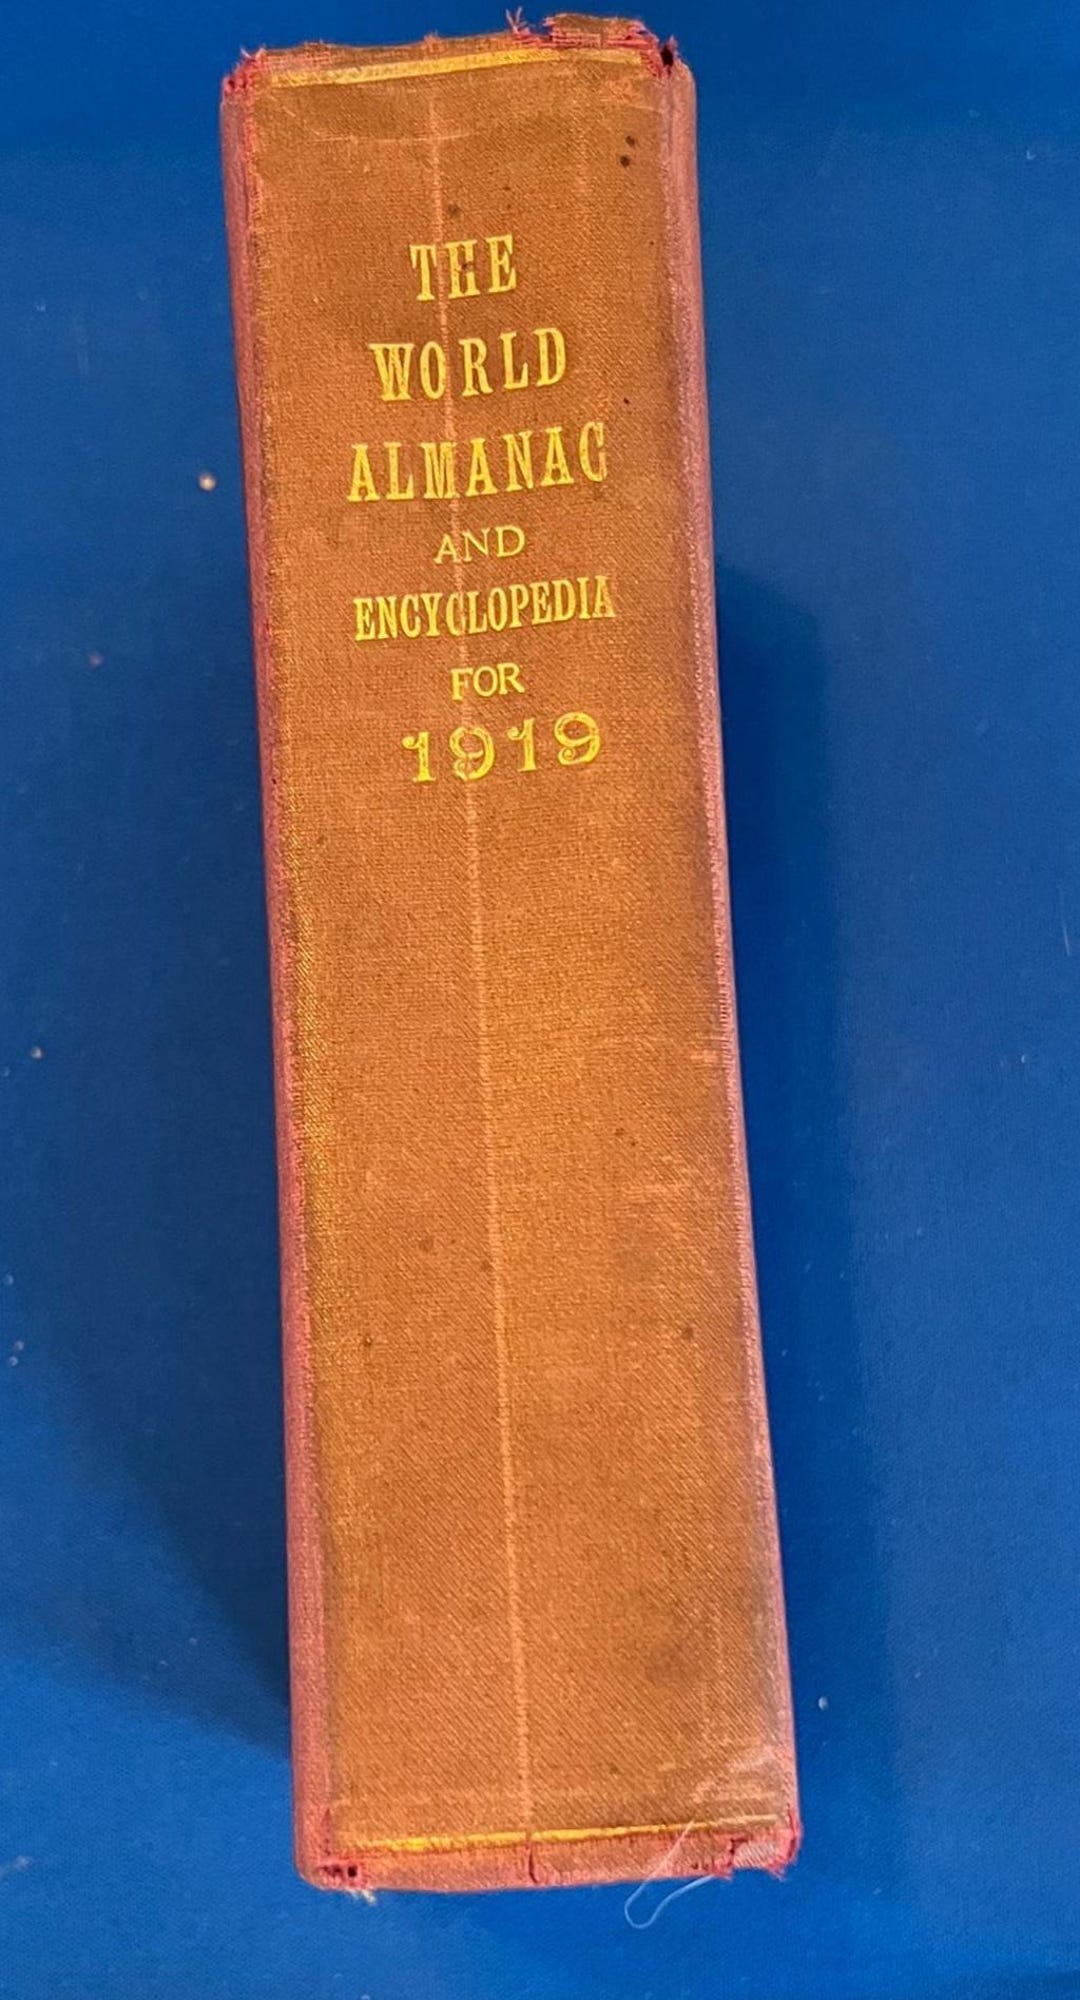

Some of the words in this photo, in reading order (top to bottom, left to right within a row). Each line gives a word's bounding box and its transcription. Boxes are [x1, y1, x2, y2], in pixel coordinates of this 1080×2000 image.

[409, 234, 517, 301] THE
[368, 327, 567, 401] WORLD
[433, 525, 526, 564] AND
[353, 575, 617, 641] ENCYCLOPEDIA
[451, 662, 525, 700] FOR
[402, 711, 602, 782] 1919
